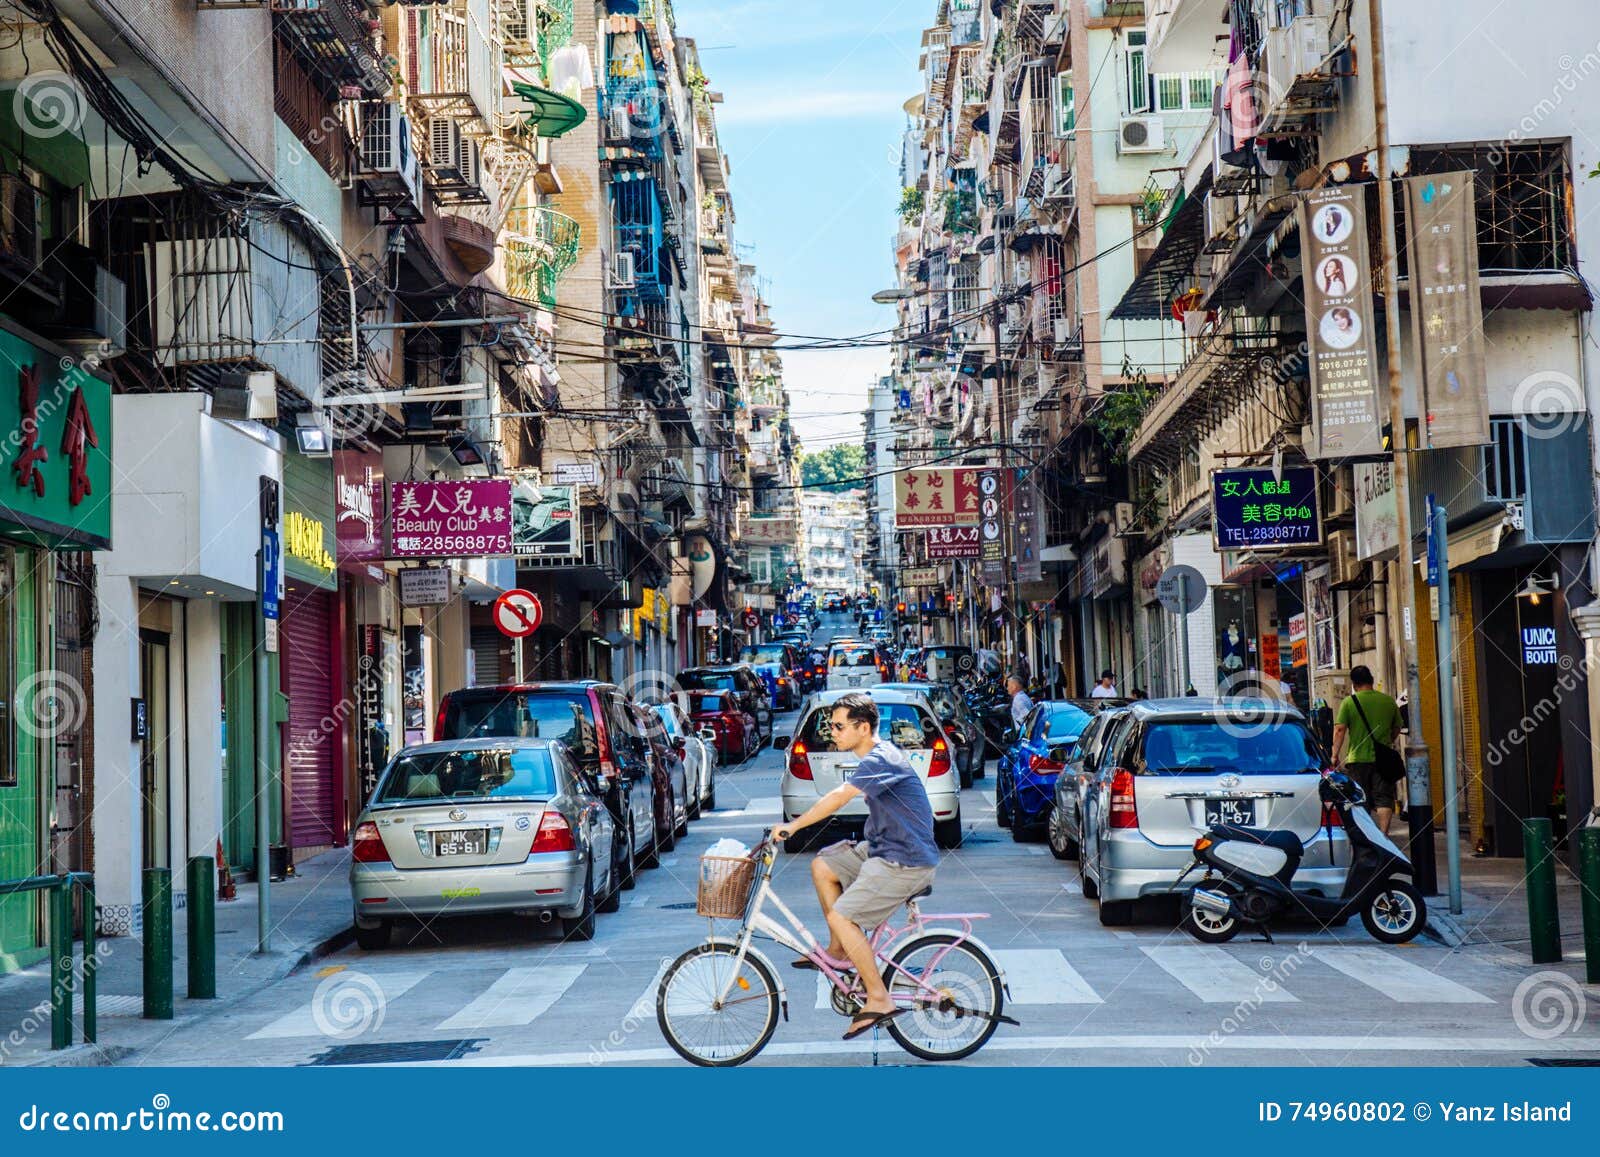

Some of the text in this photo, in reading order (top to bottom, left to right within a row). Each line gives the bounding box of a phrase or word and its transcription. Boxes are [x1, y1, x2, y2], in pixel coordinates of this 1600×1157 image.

[1319, 358, 1368, 370] 2016.07.02
[1327, 368, 1361, 379] 8:00PM
[397, 486, 477, 517] 美人兒
[478, 506, 506, 524] 美容
[1242, 503, 1312, 523] 美容中心
[396, 516, 478, 535] Beauty Club
[1226, 525, 1311, 541] TEL:28308717
[1219, 800, 1239, 814] MK
[1209, 811, 1252, 825] 21-67
[450, 831, 468, 843] MK
[439, 841, 481, 855] 65-61
